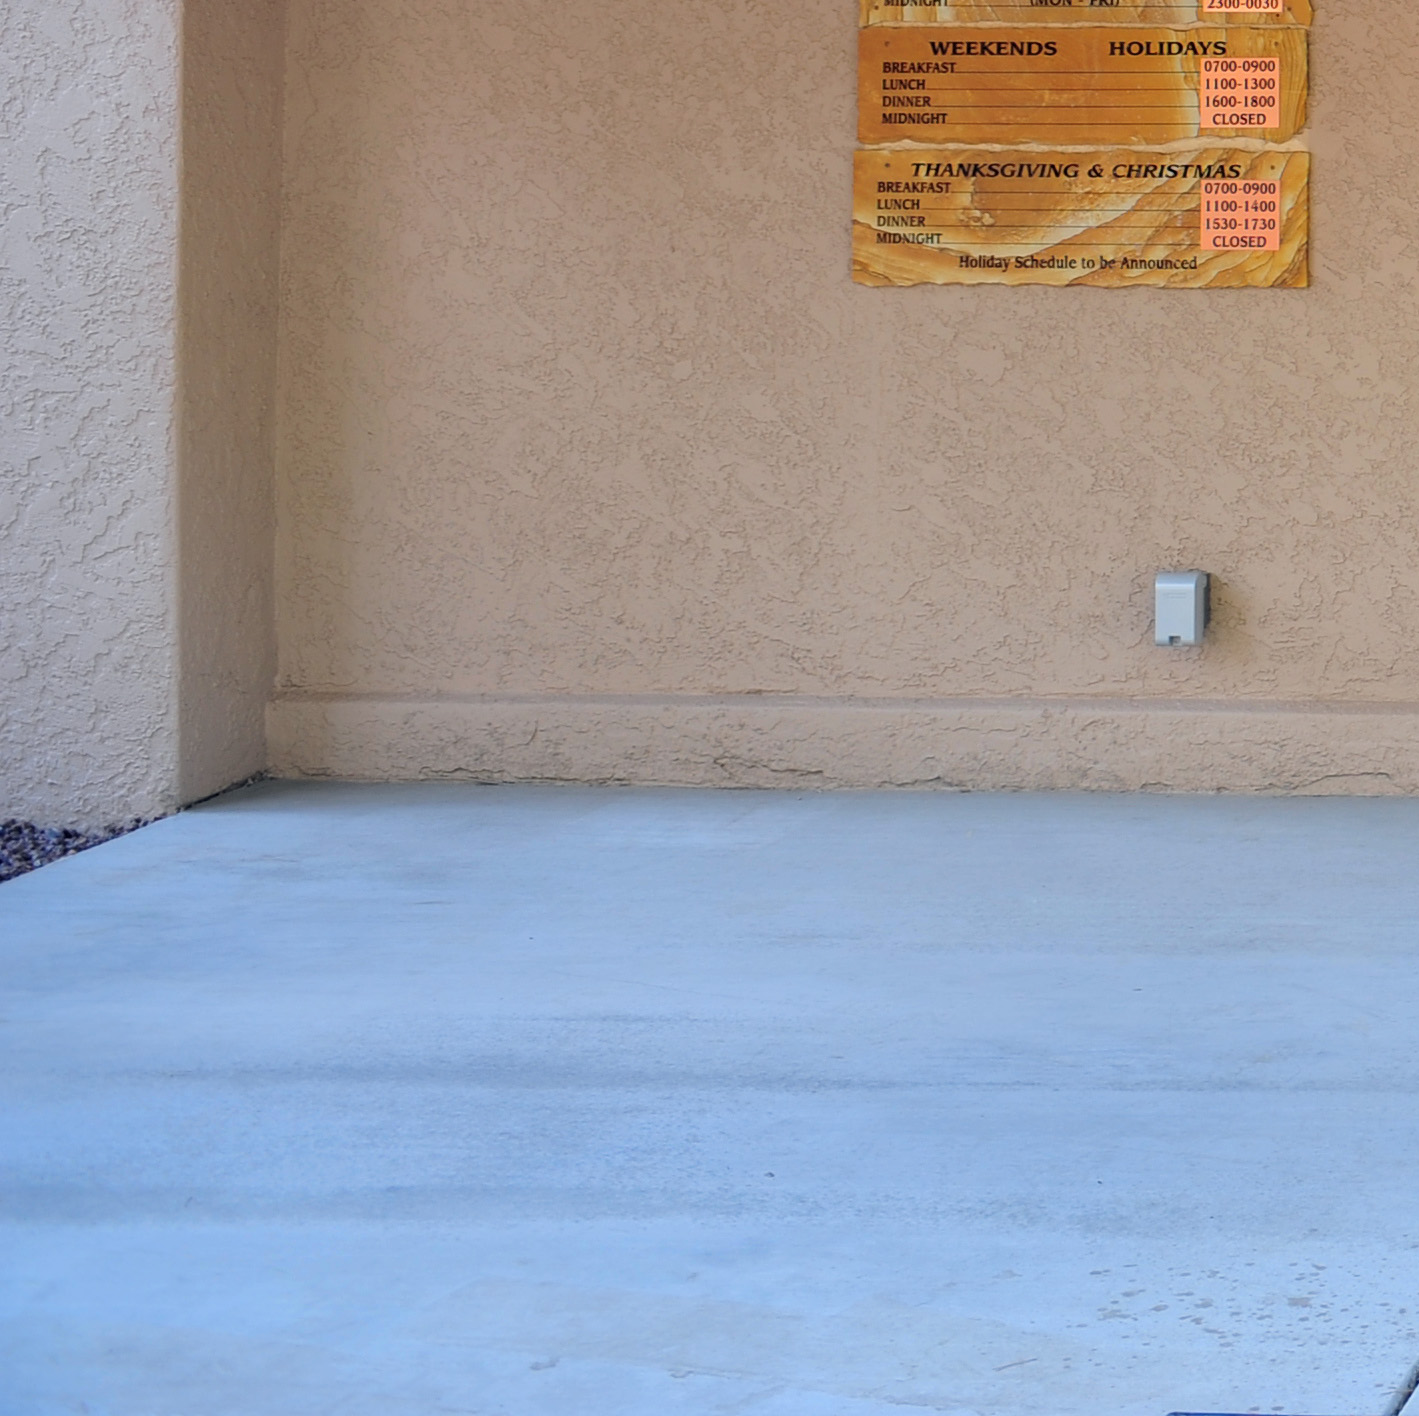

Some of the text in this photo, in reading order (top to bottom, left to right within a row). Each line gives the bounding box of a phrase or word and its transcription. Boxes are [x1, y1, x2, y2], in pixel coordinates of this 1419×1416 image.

[930, 41, 1227, 56] WEEKENDS HOLIDAYS
[882, 61, 1275, 73] BREAKFAST 0700-0900
[882, 78, 1275, 90] LUNCH 1100-1300
[882, 95, 1275, 107] DINNER 1600-1800
[881, 113, 1266, 125] MIDNIGHT CLOSED
[912, 163, 1241, 179] THANKSGIVING & CHRISTMAS
[878, 182, 1276, 195] BREAKFAST 0700-0900
[877, 199, 1275, 212] LUNCH 1100-1400
[877, 215, 1275, 230] DINNER 1530-1730
[876, 233, 1266, 248] MIDNIGHT CLOSED
[959, 255, 1197, 272] Holiday Schedule to be Announced
